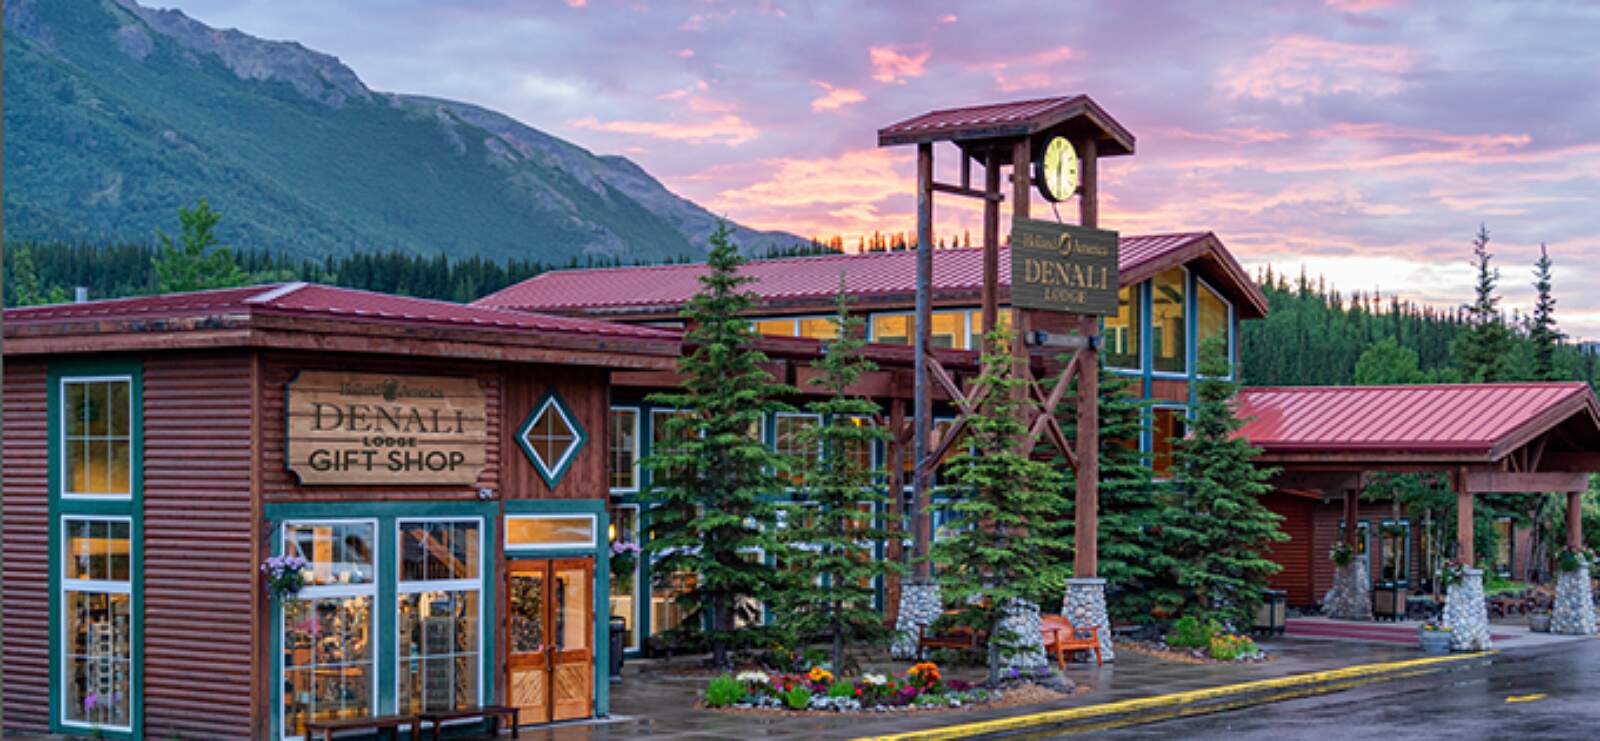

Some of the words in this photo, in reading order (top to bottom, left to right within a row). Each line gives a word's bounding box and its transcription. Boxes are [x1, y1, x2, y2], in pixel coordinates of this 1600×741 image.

[1024, 257, 1107, 290] DENALI
[310, 402, 464, 433] DENALI
[362, 437, 417, 448] LODGE
[308, 449, 378, 471] GIFT
[387, 451, 464, 471] SHOP
